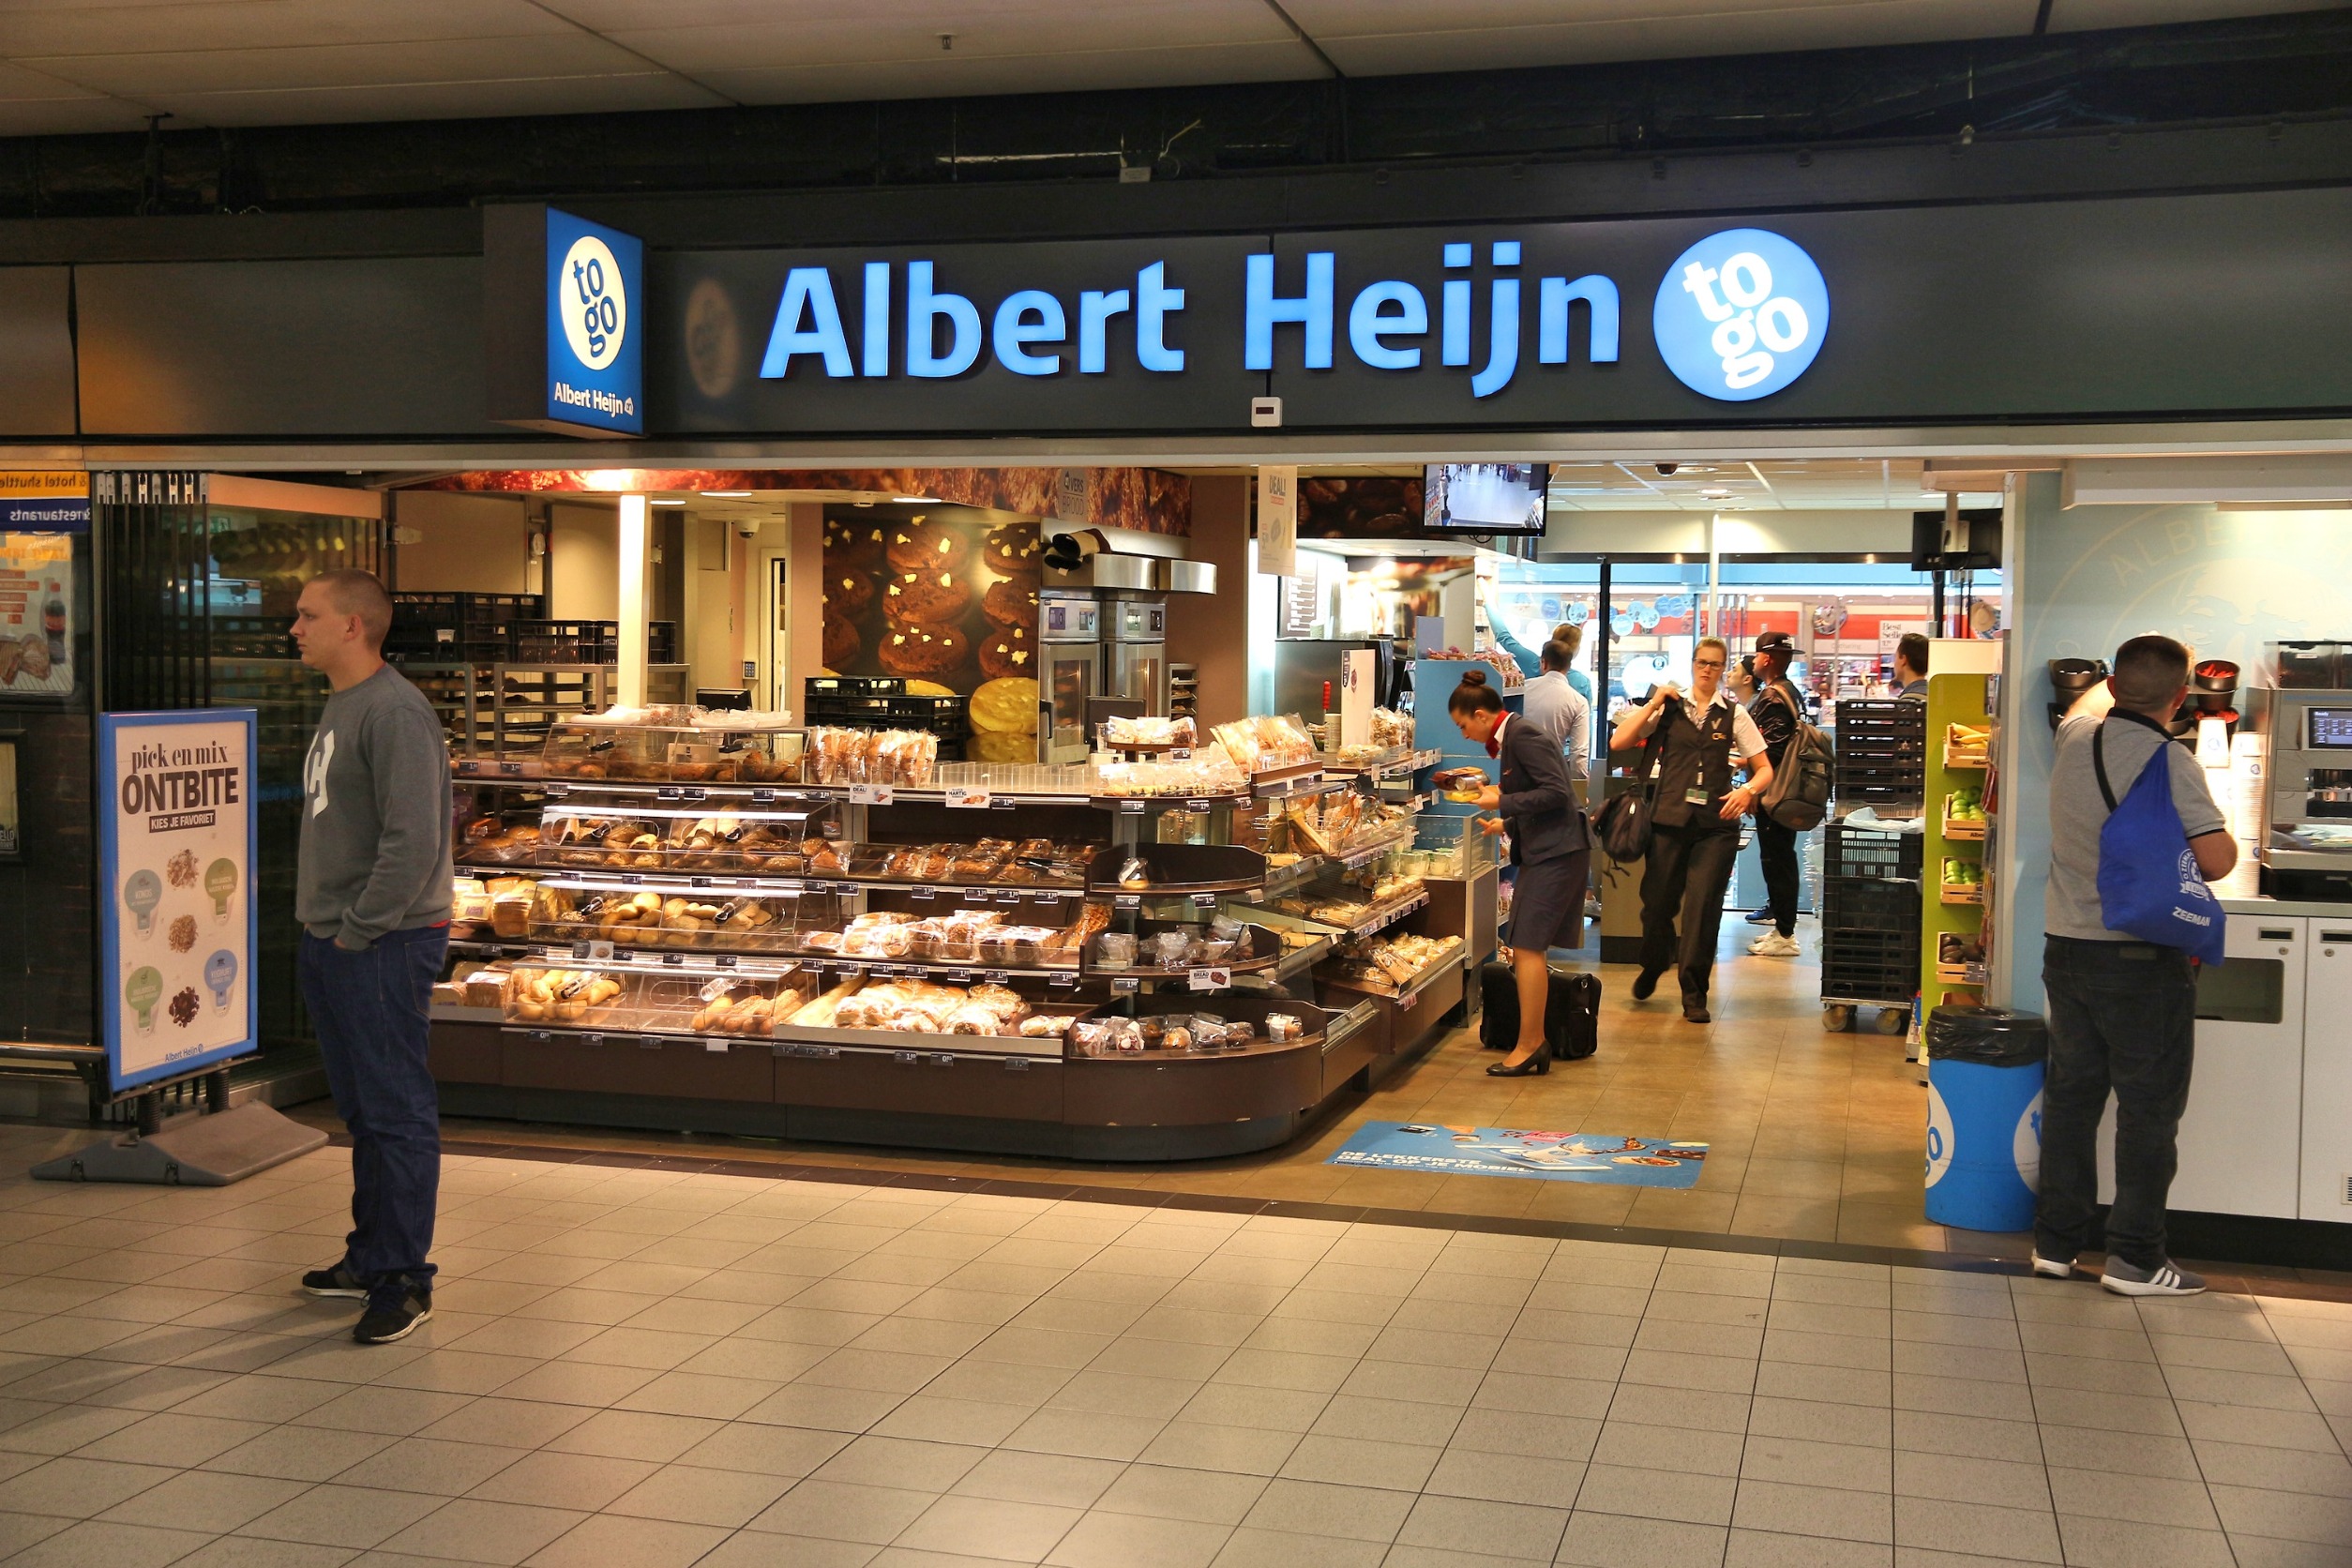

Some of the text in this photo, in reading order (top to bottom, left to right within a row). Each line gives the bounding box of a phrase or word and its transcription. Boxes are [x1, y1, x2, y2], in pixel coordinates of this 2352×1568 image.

[573, 258, 604, 305] to
[1682, 251, 1773, 323] to
[584, 295, 617, 358] go
[760, 241, 1621, 399] Albert Heijn
[1711, 296, 1809, 390] go
[554, 382, 591, 409] Albert
[593, 390, 624, 417] Heijn
[1269, 475, 1287, 497] DEAL!
[131, 740, 229, 774] pick en mix
[122, 767, 239, 815] ONTBITE
[151, 812, 215, 830] KIES JE FAVORIET
[2172, 906, 2211, 927] ZEEMAN
